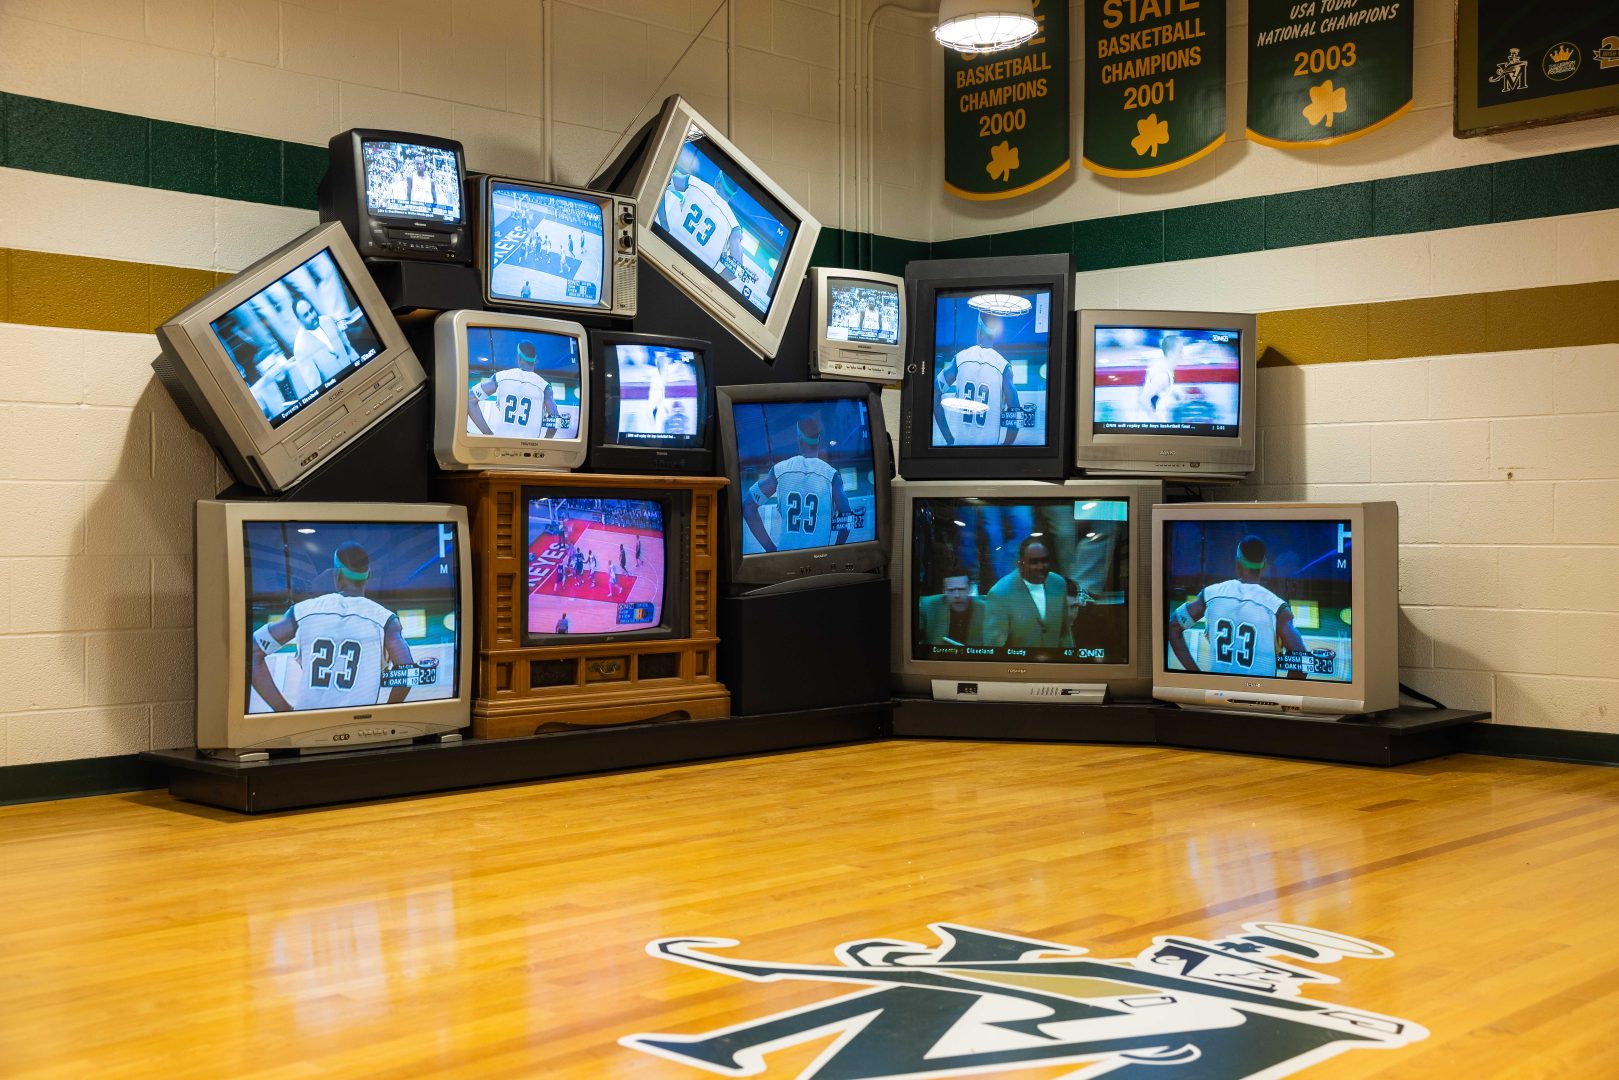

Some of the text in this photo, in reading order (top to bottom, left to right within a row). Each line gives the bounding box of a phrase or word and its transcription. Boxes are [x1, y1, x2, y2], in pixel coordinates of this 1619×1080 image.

[1257, 3, 1400, 47] NATIONAL CHAMPIONS
[1290, 2, 1316, 20] USA
[1098, 17, 1206, 59] BASKETBALL
[956, 51, 1052, 89] BASKETBALL
[1101, 46, 1202, 85] CHAMPIONS
[1294, 42, 1357, 76] 2003
[960, 78, 1048, 113] CHAMPIONS
[1124, 78, 1175, 110] 2001
[979, 107, 1027, 138] 2000
[683, 203, 717, 247] 23
[504, 394, 532, 427] 23
[786, 490, 820, 536] 23
[439, 564, 449, 574] M
[1337, 558, 1347, 569] M
[966, 647, 995, 655] Cleveland
[1007, 648, 1027, 657] Cloudy
[1215, 616, 1258, 670] 23
[309, 636, 363, 692] 23
[389, 669, 407, 678] SVSM
